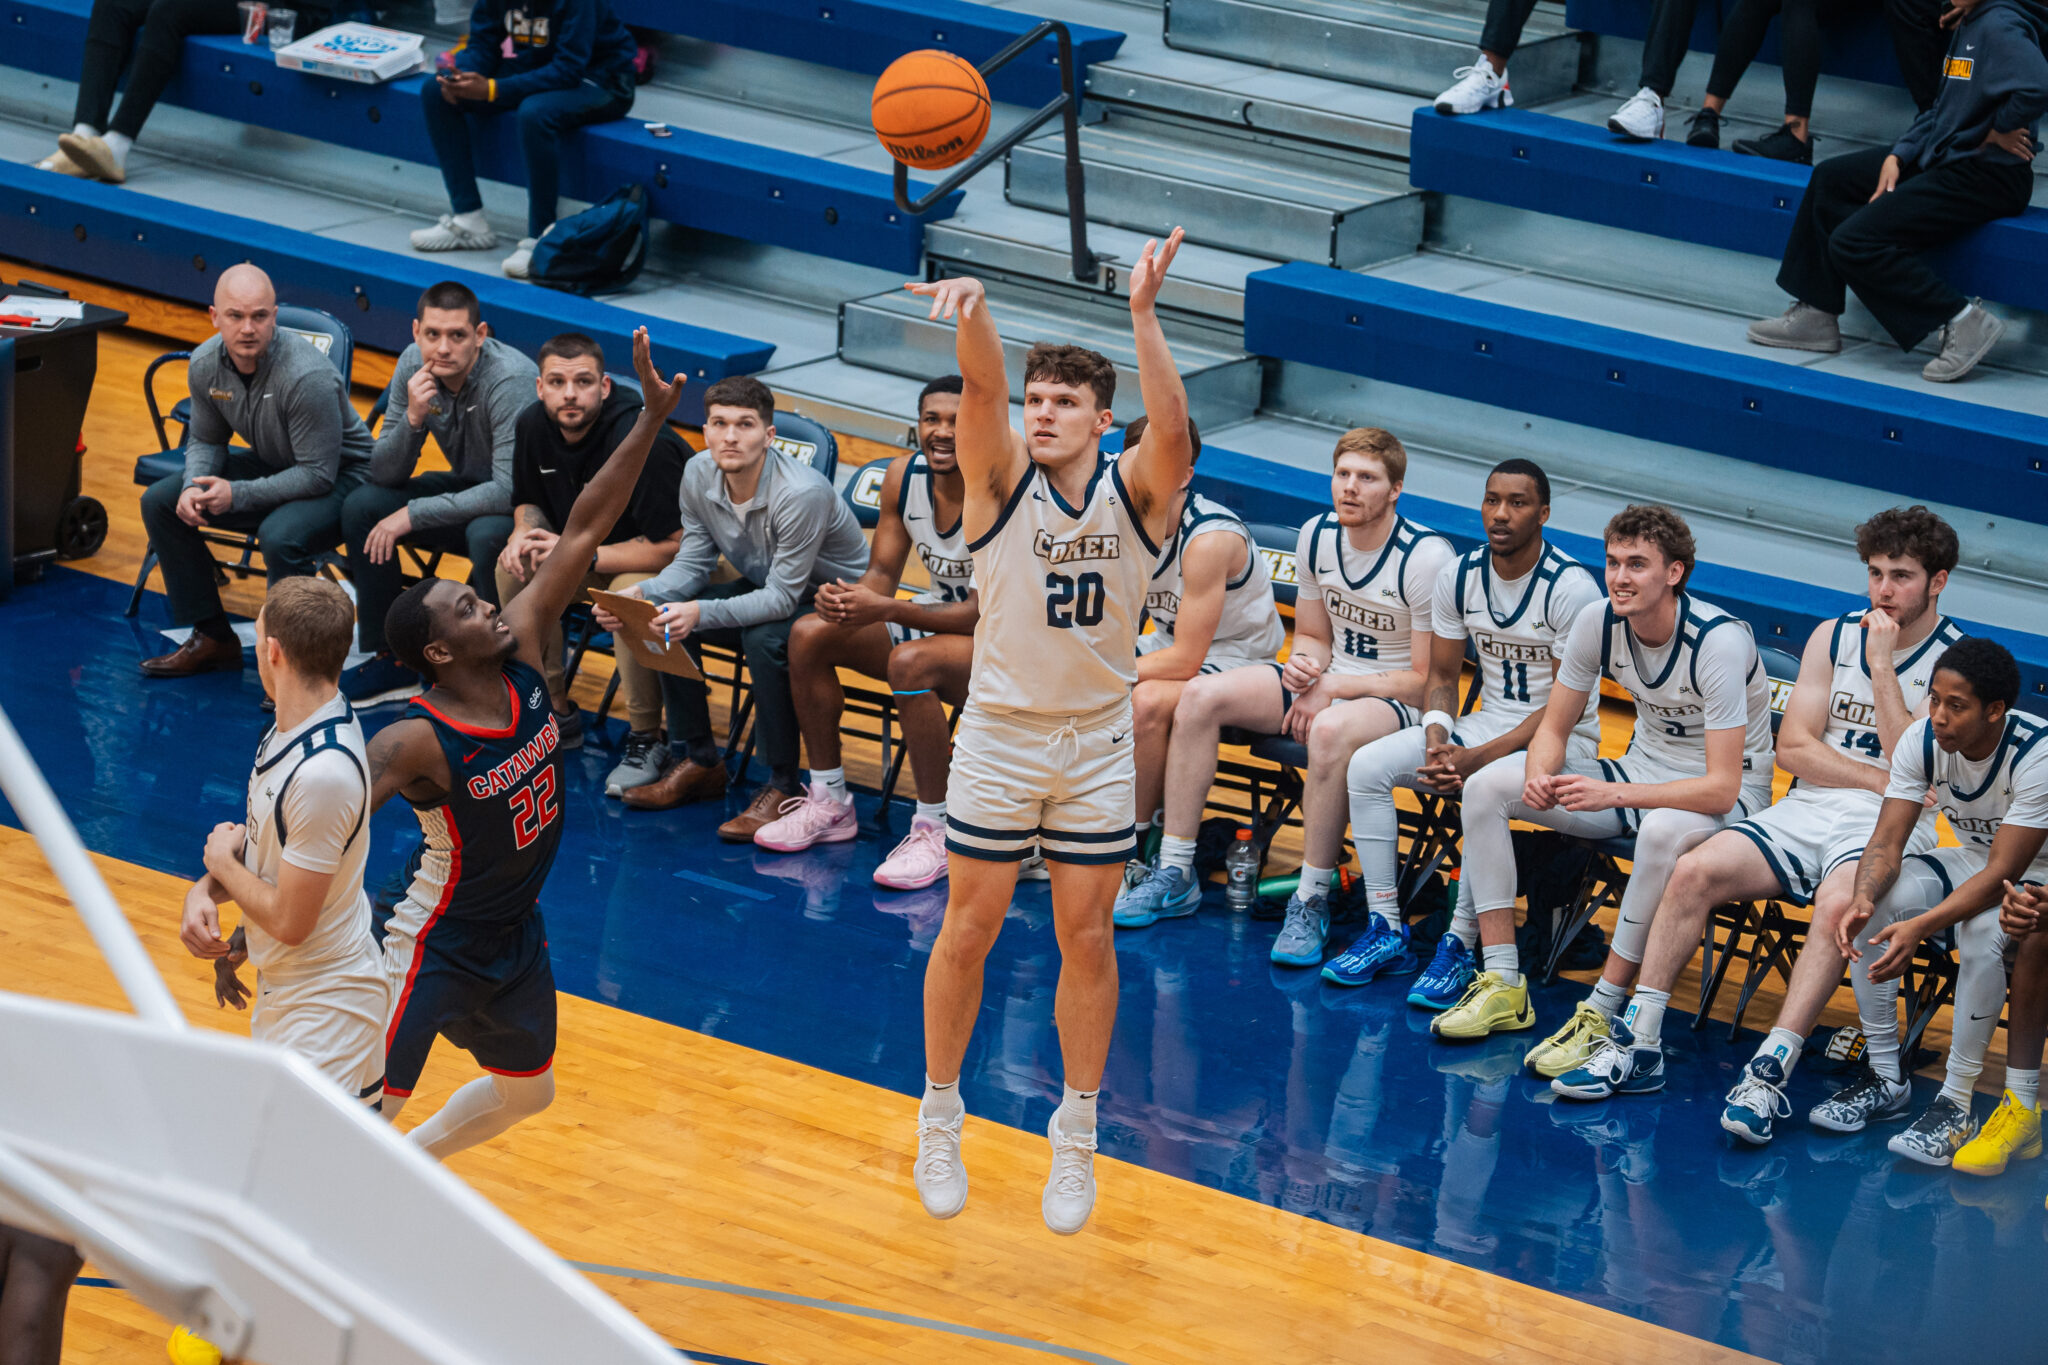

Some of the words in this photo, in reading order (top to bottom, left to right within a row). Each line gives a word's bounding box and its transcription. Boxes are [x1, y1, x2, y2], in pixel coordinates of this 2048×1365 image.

[886, 136, 964, 160] Wilson
[1105, 267, 1116, 291] B
[906, 427, 919, 448] A
[1033, 529, 1120, 565] COKER
[1046, 572, 1105, 628] 20
[1326, 589, 1396, 632] COKER
[1344, 627, 1379, 660] 12
[1475, 631, 1553, 662] COKER
[529, 686, 542, 707] SAC
[1501, 659, 1531, 703] 11
[1841, 729, 1883, 758] 14
[508, 764, 558, 850] 22
